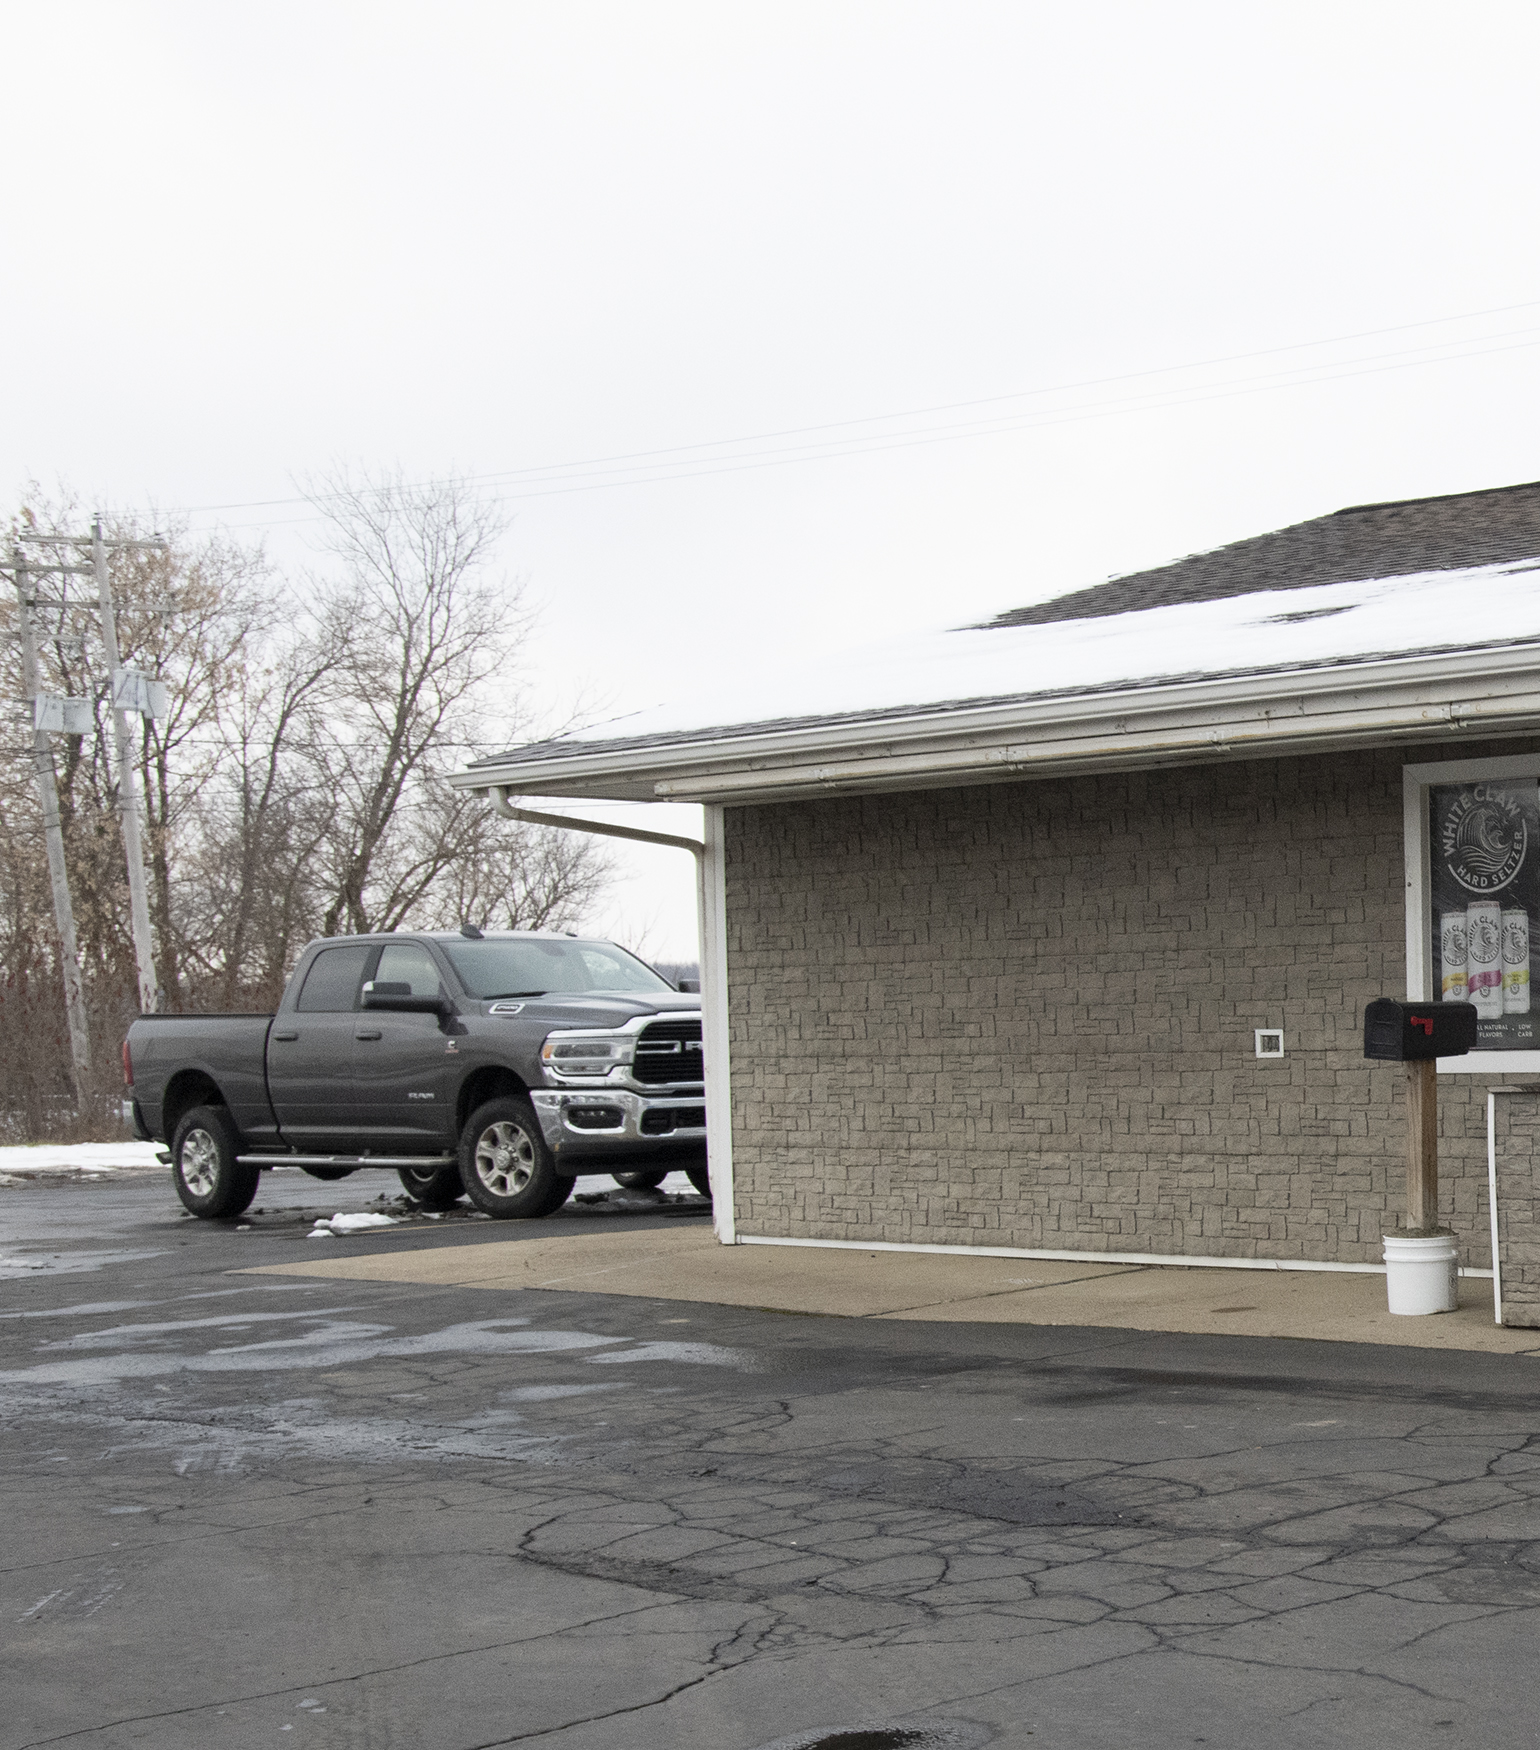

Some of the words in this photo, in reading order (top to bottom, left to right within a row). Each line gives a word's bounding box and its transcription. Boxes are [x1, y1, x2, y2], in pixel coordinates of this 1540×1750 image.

[1442, 792, 1473, 857] WHITE
[1473, 785, 1520, 817] CLAW
[1457, 864, 1488, 887] HARD
[1491, 831, 1522, 885] SELTZER
